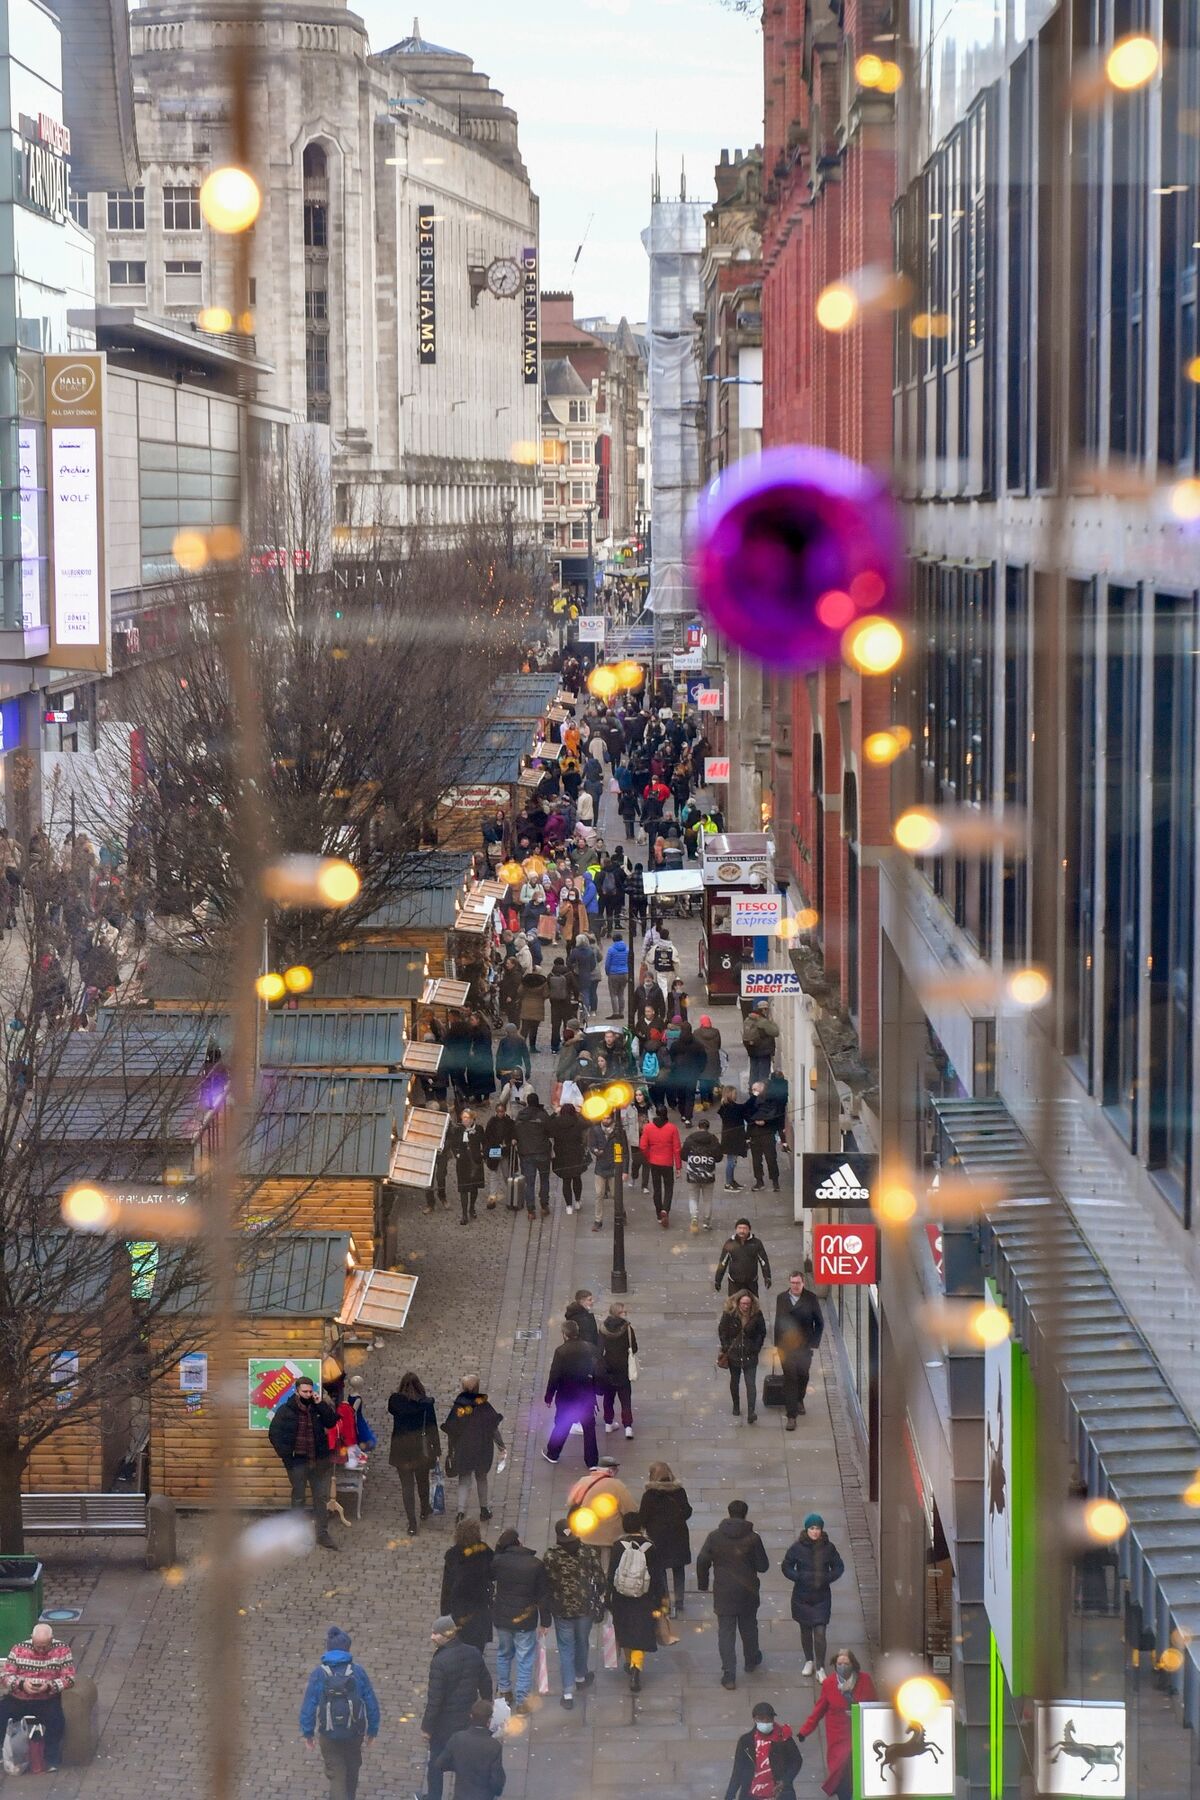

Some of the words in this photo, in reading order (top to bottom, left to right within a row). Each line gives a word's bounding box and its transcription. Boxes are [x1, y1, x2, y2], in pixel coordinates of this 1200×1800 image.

[420, 216, 434, 353] DEBENHAMS
[525, 258, 537, 375] DEBENHAMS
[60, 494, 90, 502] WOLF
[736, 902, 778, 911] TESCO
[736, 916, 778, 927] express
[746, 974, 799, 984] SPORTS
[688, 1155, 714, 1165] KORS
[815, 1186, 870, 1200] adidas
[262, 1372, 292, 1400] WASH
